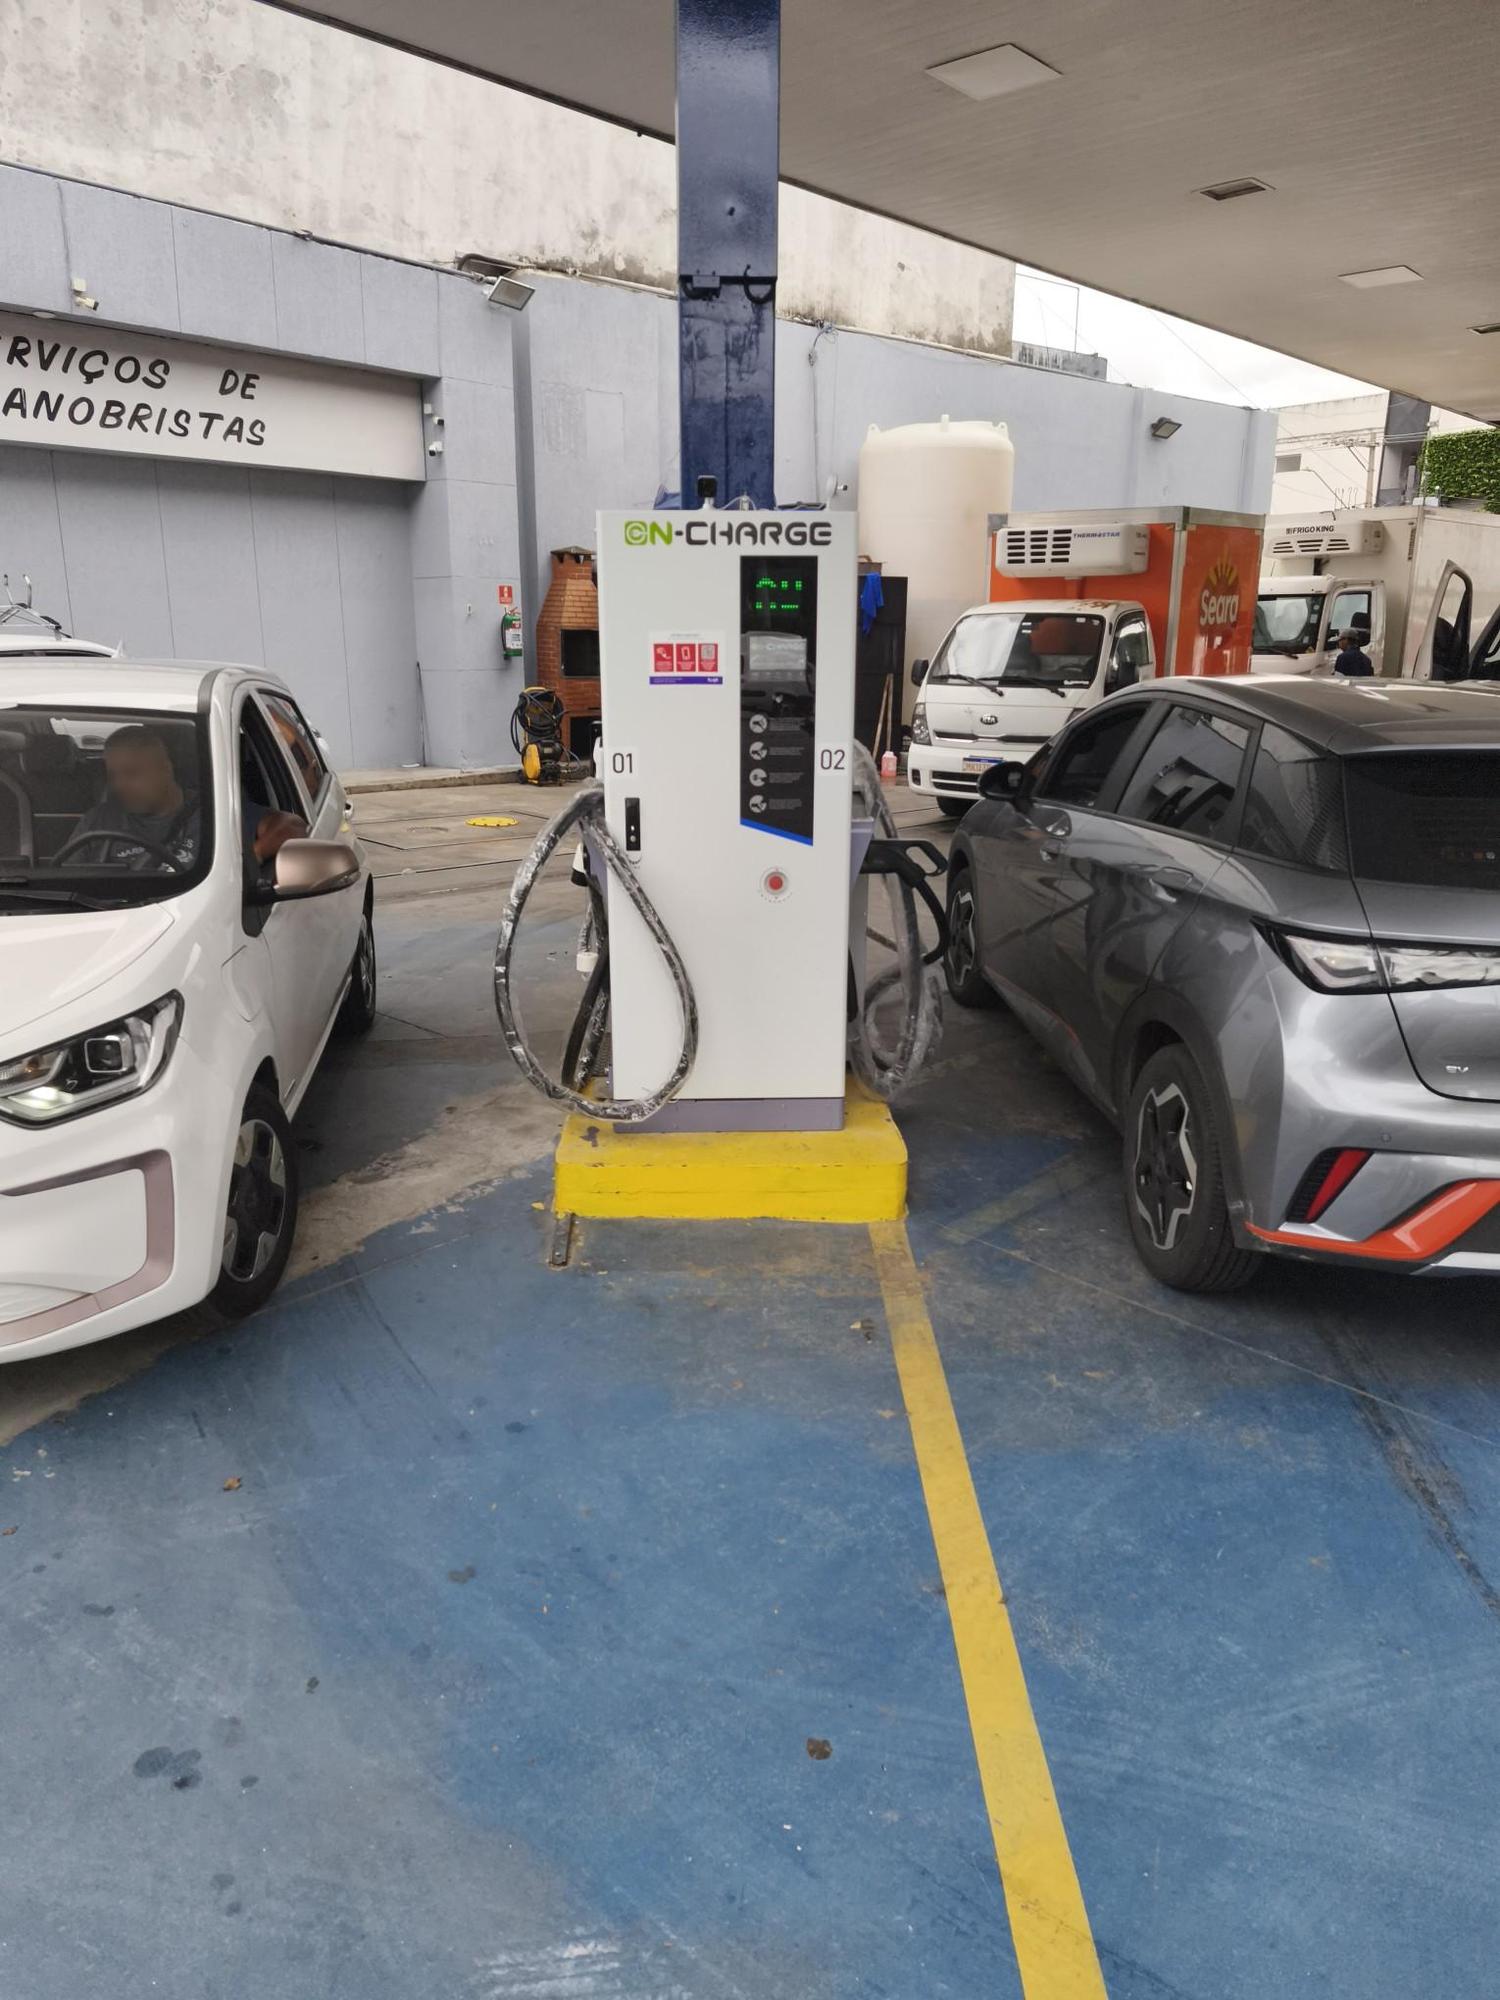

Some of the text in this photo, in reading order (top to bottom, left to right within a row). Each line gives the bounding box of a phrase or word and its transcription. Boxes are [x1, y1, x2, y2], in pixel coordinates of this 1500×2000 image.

[0, 336, 260, 400] RVIÇOS DE
[1200, 589, 1239, 625] Seara
[613, 752, 632, 774] 01
[820, 749, 845, 770] 02
